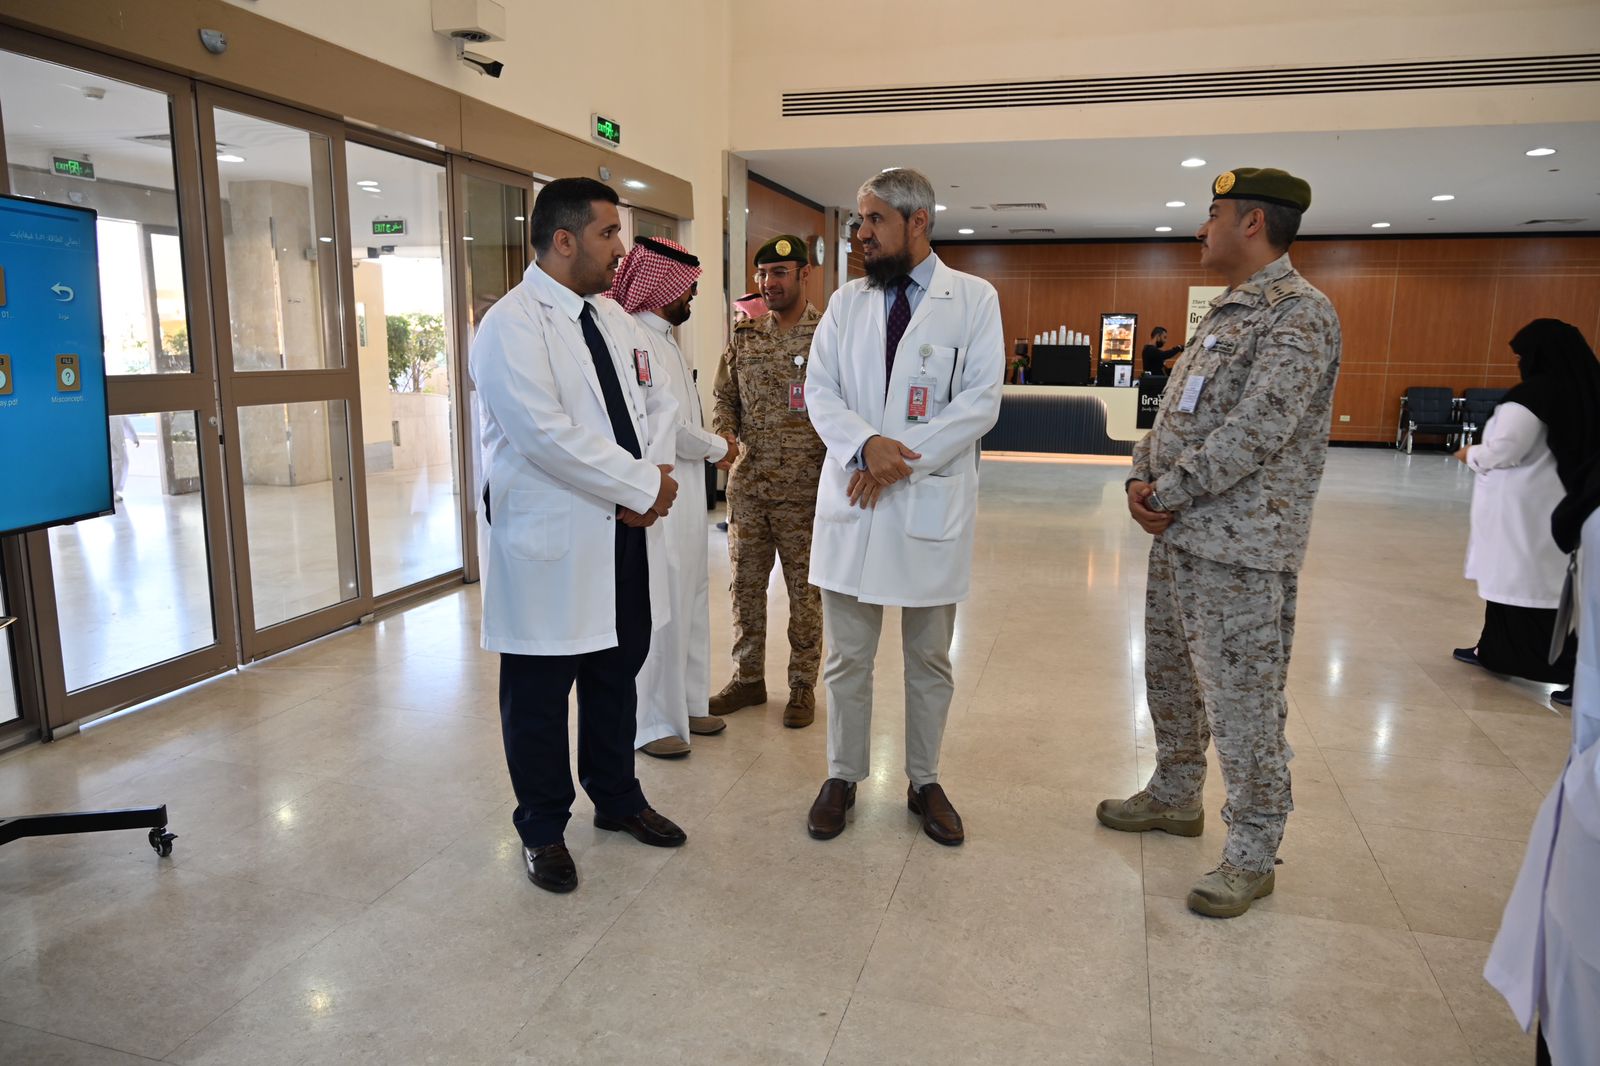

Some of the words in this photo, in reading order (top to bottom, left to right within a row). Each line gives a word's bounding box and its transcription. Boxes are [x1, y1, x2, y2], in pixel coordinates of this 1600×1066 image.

[55, 161, 69, 170] EXIT
[374, 223, 385, 233] EXIT
[1190, 312, 1202, 324] Gr
